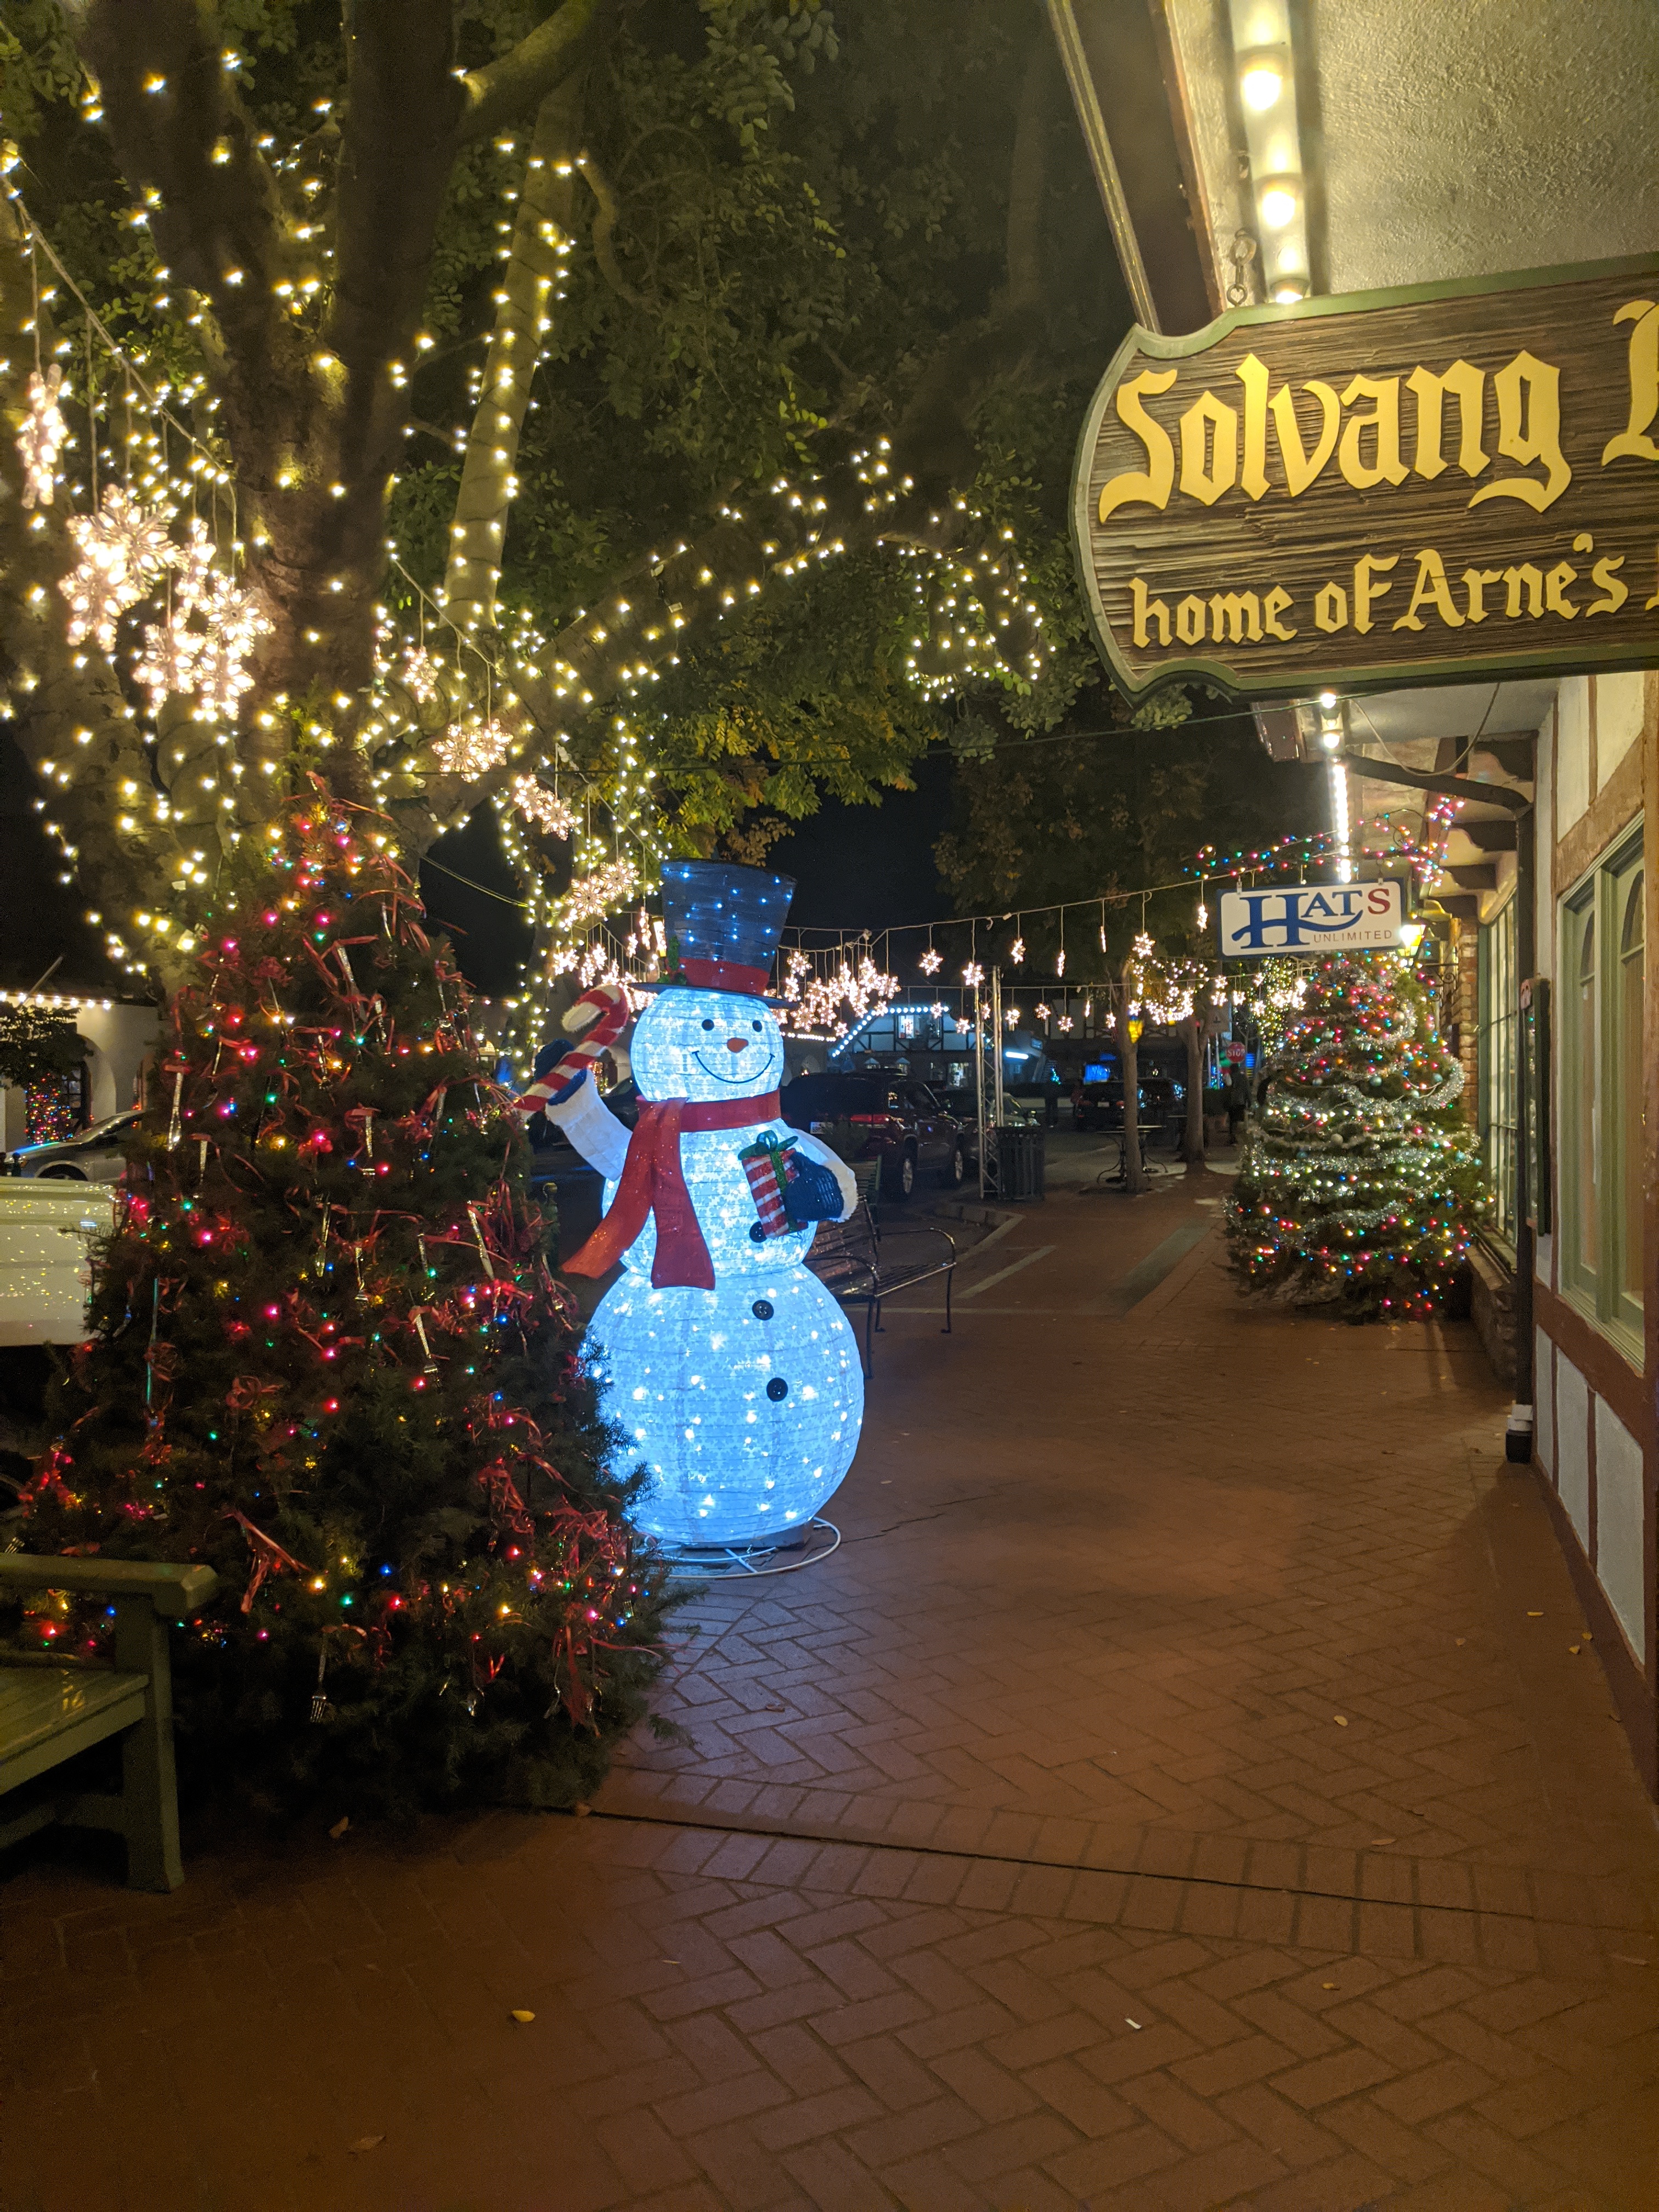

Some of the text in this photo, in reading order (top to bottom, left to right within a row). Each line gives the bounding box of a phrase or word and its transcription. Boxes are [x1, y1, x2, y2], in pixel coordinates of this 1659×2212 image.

[1099, 349, 1572, 522] Solvang
[1128, 576, 1297, 648] home
[1392, 533, 1629, 631] Arne's
[1231, 888, 1391, 949] HATS
[1313, 930, 1392, 943] UNLIMITED
